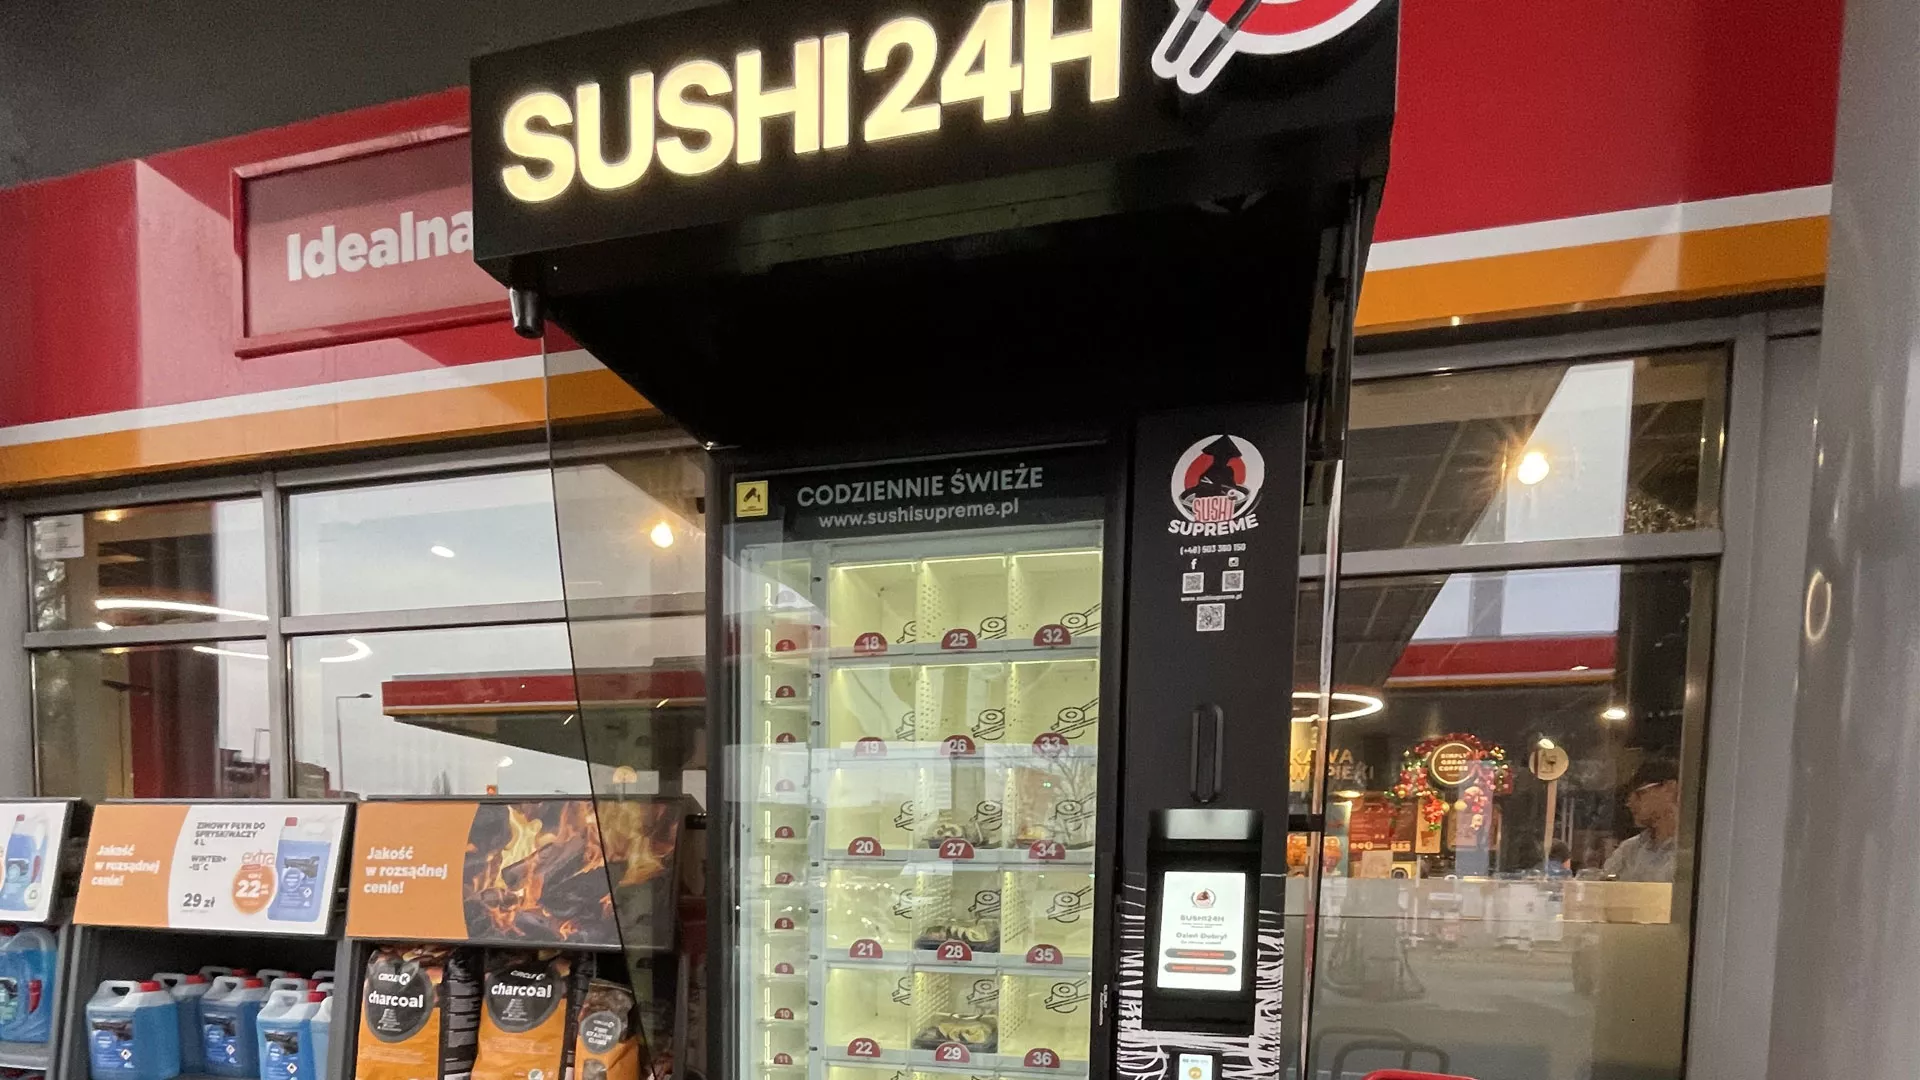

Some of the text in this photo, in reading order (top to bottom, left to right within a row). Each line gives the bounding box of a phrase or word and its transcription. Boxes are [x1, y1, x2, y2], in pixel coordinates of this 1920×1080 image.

[287, 210, 474, 282] Idealna
[797, 462, 1043, 507] CODZIENNIE ŚWIEŻE
[819, 497, 1019, 528] www.sushisupreme.pl
[1192, 496, 1235, 523] SUSHI
[1168, 513, 1259, 537] SUPREME
[949, 633, 969, 646] 25
[1042, 629, 1063, 643] 32
[862, 637, 879, 650] 18
[948, 739, 967, 752] 26
[1290, 763, 1374, 781] WPIEKI
[366, 846, 414, 860] Jakość
[855, 840, 874, 854] 20
[946, 842, 966, 856] 27
[1036, 842, 1057, 856] 34
[95, 862, 105, 871] w
[365, 863, 448, 880] w rozsądnej
[363, 881, 405, 894] cenie!
[183, 893, 215, 907] 29 zł
[857, 943, 874, 956] 21
[945, 945, 964, 959] 28
[1034, 948, 1055, 961] 35
[491, 982, 552, 998] charcoal
[368, 990, 424, 1008] charcoal
[855, 1042, 873, 1055] 22
[943, 1047, 962, 1061] 29
[1032, 1052, 1052, 1066] 36
